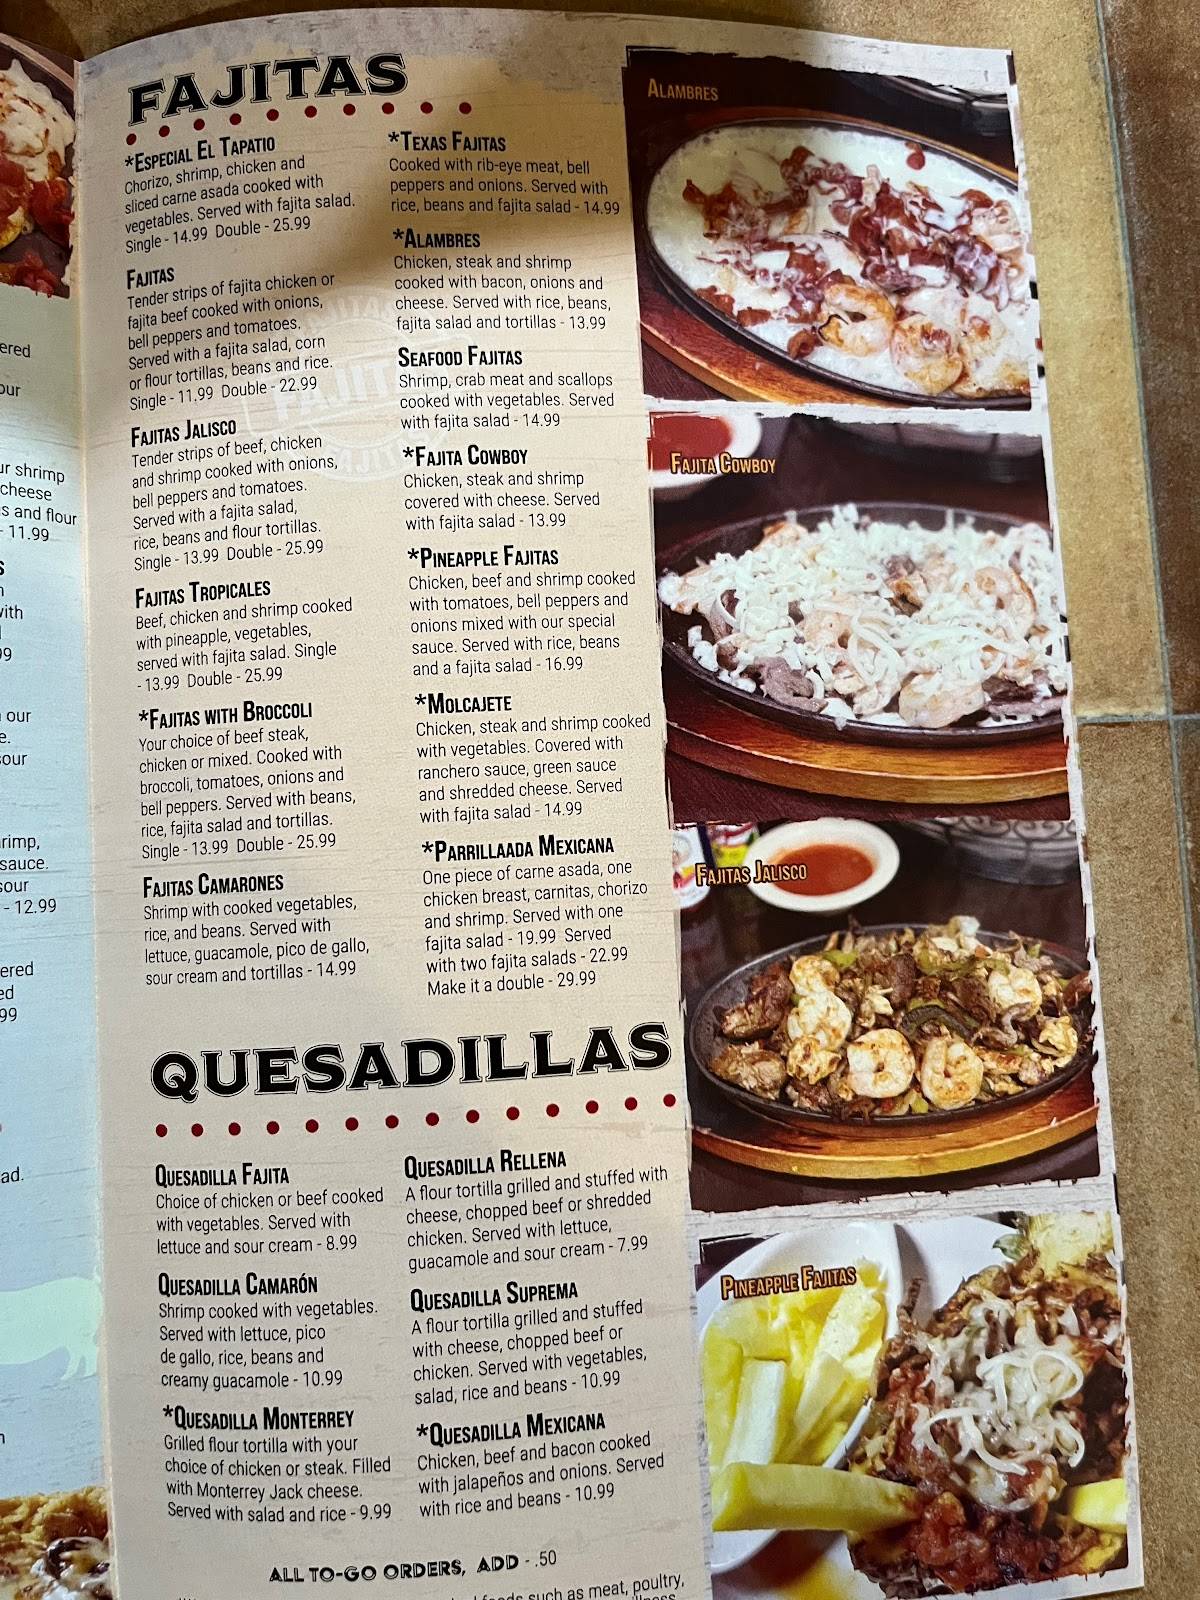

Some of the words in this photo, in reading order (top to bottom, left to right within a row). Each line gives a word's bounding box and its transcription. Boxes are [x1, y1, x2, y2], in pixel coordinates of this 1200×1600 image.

[128, 53, 409, 127] FAJITAS
[124, 175, 172, 195] Chorizo,
[175, 166, 223, 184] shrimp,
[226, 158, 277, 176] chicken
[280, 154, 305, 171] and
[389, 156, 440, 172] Cooked
[444, 156, 473, 172] with
[477, 157, 522, 176] rib-eye
[526, 160, 563, 176] meat,
[566, 159, 590, 175] bell
[125, 234, 162, 254] Single
[173, 226, 208, 245] 14.99
[215, 219, 261, 239] Double
[272, 215, 311, 233] 25.99
[395, 295, 448, 310] cheese.
[452, 294, 499, 309] Served
[503, 294, 532, 309] with
[536, 295, 564, 311] rice,
[567, 295, 611, 312] beans,
[399, 373, 452, 391] Shrimp,
[455, 372, 486, 387] crab
[489, 373, 525, 386] meat
[528, 371, 553, 386] and
[557, 371, 613, 390] scallops
[15, 463, 65, 486] shrimp
[0, 481, 52, 501] cheese
[14, 506, 41, 521] and
[46, 507, 77, 526] flour
[9, 524, 50, 541] 11.99
[136, 612, 166, 630] Beef,
[169, 608, 219, 626] chicken
[222, 604, 247, 621] and
[251, 602, 298, 619] shrimp
[302, 596, 353, 615] cooked
[6, 711, 32, 723] our
[140, 776, 193, 795] broccoli,
[196, 774, 264, 791] tomatoes,
[267, 769, 314, 786] onions
[318, 766, 344, 783] and
[418, 763, 480, 780] ranchero
[484, 764, 529, 777] sauce,
[533, 762, 572, 778] green
[576, 760, 617, 773] sauce
[0, 858, 49, 871] sauce.
[15, 898, 57, 914] 12.99
[423, 890, 478, 907] chicken
[482, 887, 530, 904] breast,
[534, 883, 594, 901] carnitas,
[597, 880, 648, 897] chorizo
[145, 948, 191, 964] lettuce,
[194, 942, 272, 965] guacamole,
[276, 941, 306, 961] pico
[310, 939, 327, 955] de
[331, 937, 369, 958] gallo,
[427, 978, 466, 996] Make
[470, 978, 480, 993] it
[484, 980, 492, 992] a
[497, 973, 544, 992] double
[557, 970, 596, 988] 29.99
[150, 1021, 673, 1103] QUESADILLAS
[406, 1208, 462, 1225] cheese,
[465, 1199, 528, 1222] chopped
[532, 1196, 564, 1215] beef
[567, 1199, 582, 1212] or
[586, 1188, 651, 1210] shredded
[413, 1363, 473, 1382] chicken.
[478, 1355, 528, 1376] Served
[532, 1353, 562, 1371] with
[566, 1345, 647, 1370] vegetables,
[161, 1374, 209, 1392] creamy
[212, 1371, 289, 1392] guacamole
[303, 1369, 343, 1387] 10.99
[418, 1475, 449, 1494] with
[452, 1471, 524, 1496] jalapeños
[528, 1465, 555, 1485] and
[559, 1462, 612, 1481] onions.
[616, 1451, 664, 1474] Served
[166, 1479, 193, 1496] with
[197, 1481, 266, 1504] Monterrey
[269, 1482, 304, 1501] Jack
[307, 1482, 363, 1500] cheese.
[269, 1567, 305, 1583] ALL
[308, 1565, 377, 1583] TO-GO
[383, 1559, 466, 1580] ORDERS,
[476, 1554, 519, 1574] ADD
[535, 1549, 557, 1568] .50
[567, 1586, 584, 1600] as
[588, 1580, 629, 1598] meat,
[632, 1573, 685, 1595] poultry,
